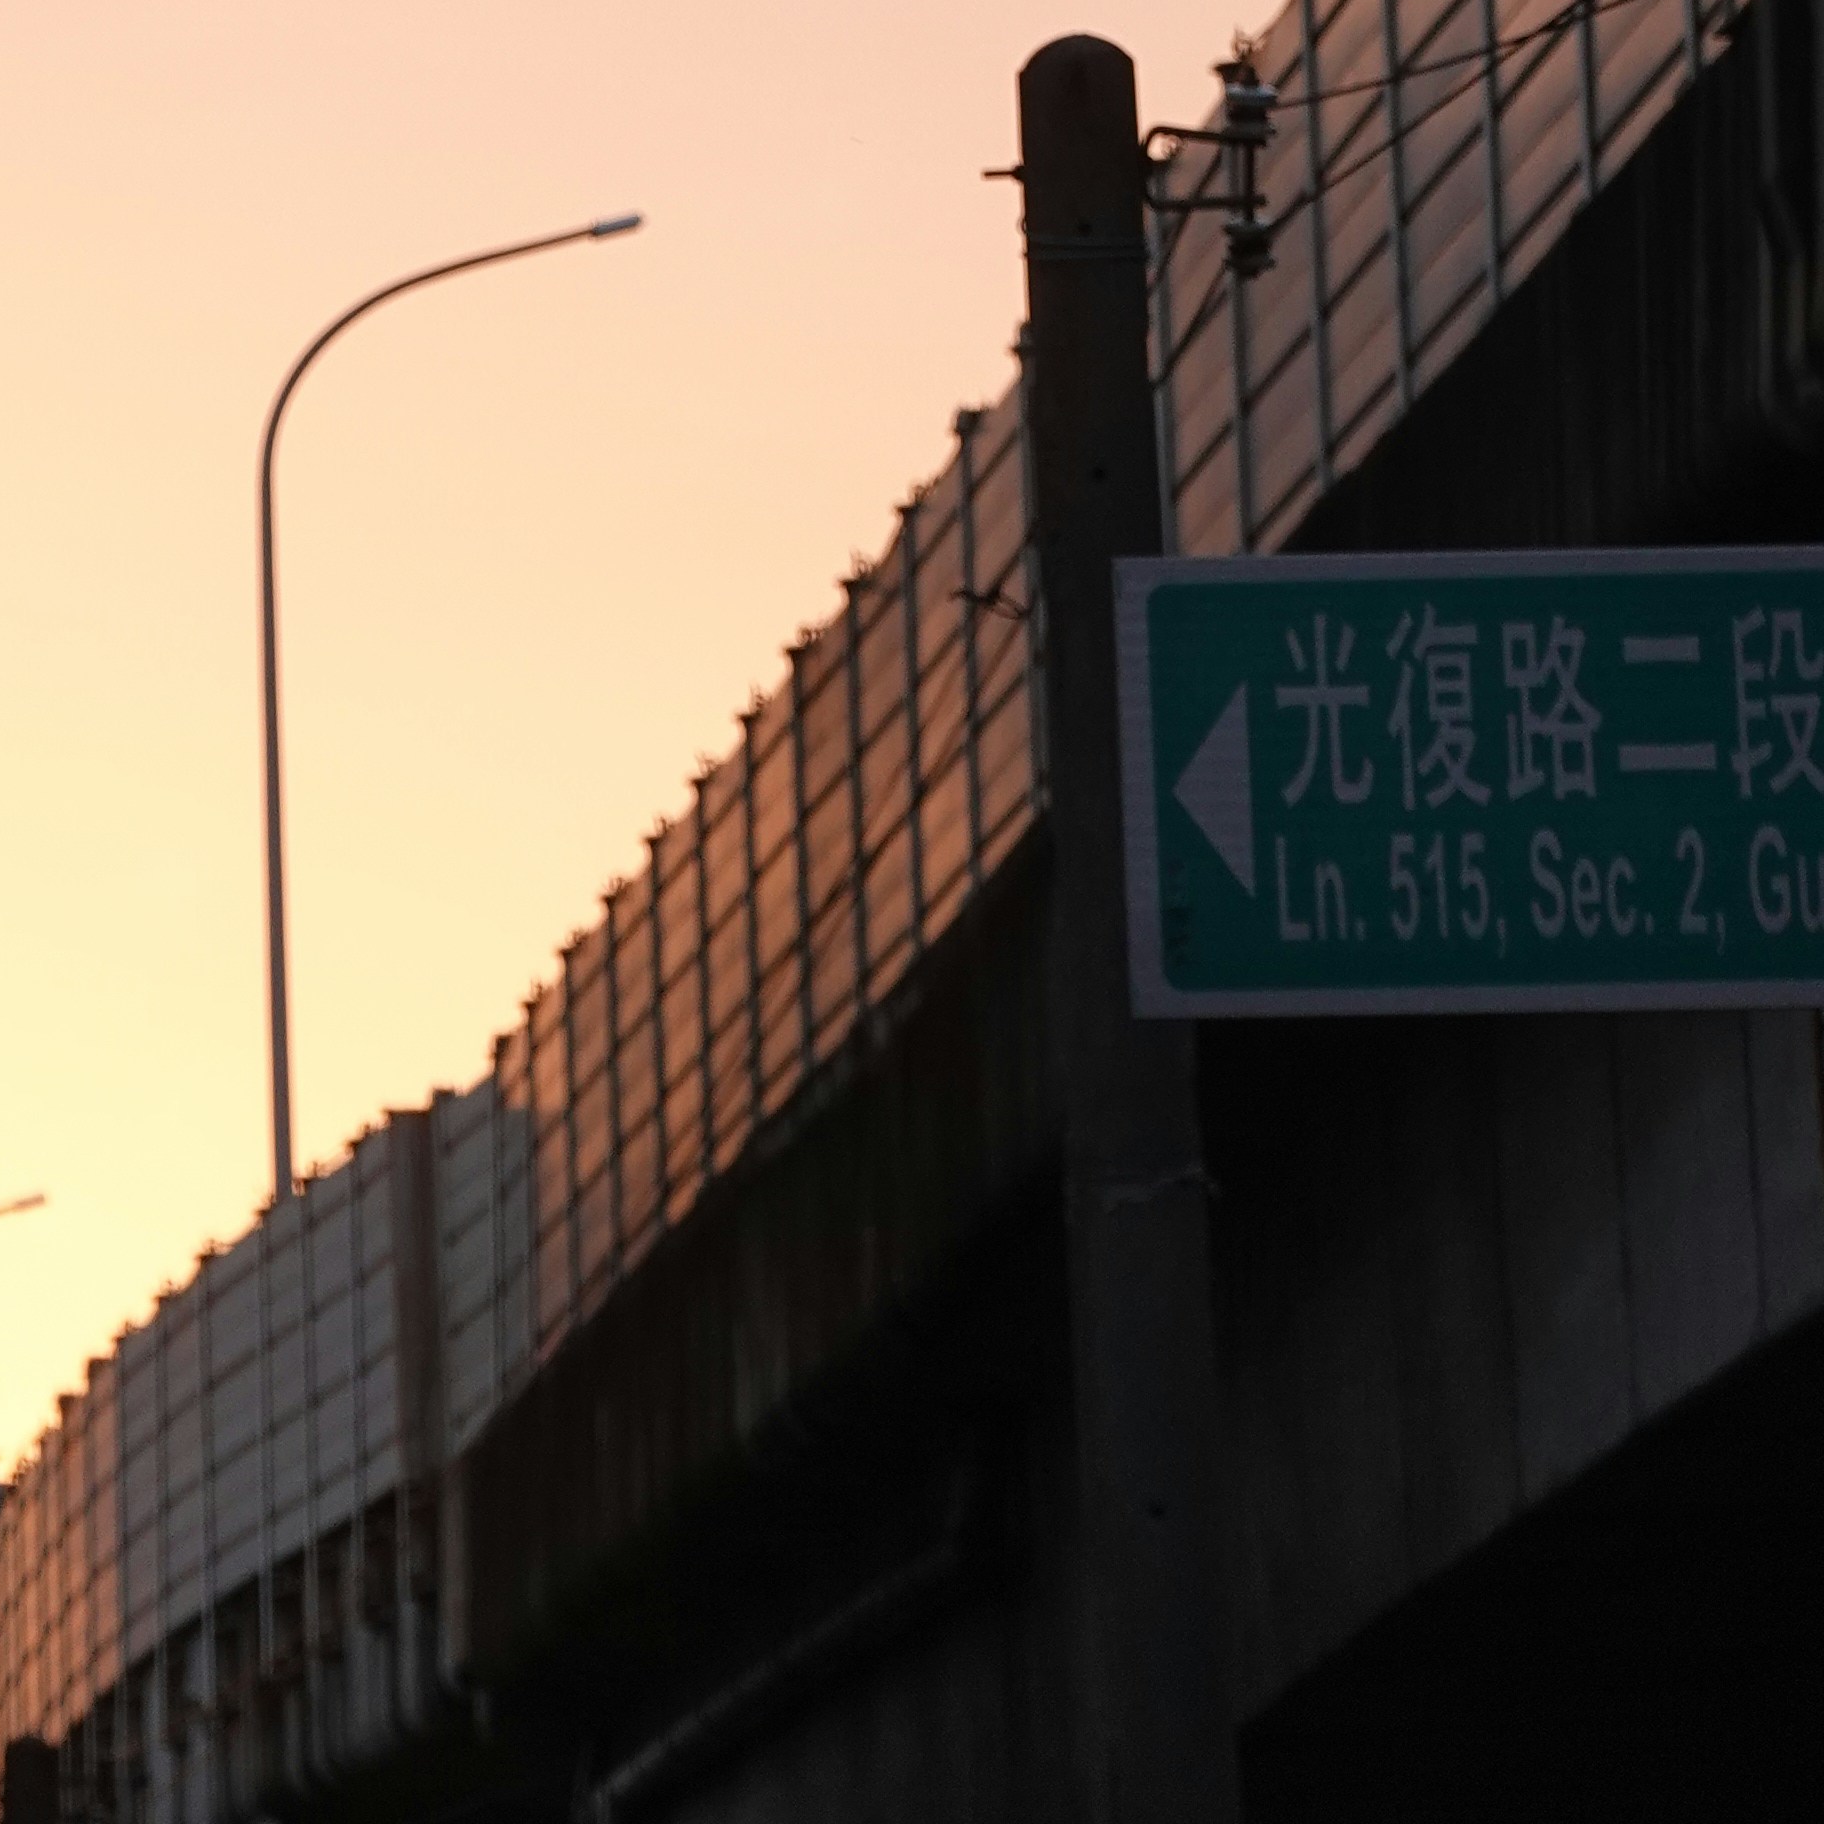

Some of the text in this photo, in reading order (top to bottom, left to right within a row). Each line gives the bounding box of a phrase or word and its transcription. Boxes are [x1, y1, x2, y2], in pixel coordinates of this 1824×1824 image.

[1275, 602, 1824, 811] 光復路二段
[1275, 832, 1367, 941] Ln.
[1389, 831, 1507, 958] 515,
[1529, 827, 1655, 938] Sec.
[1675, 825, 1726, 954] 2,
